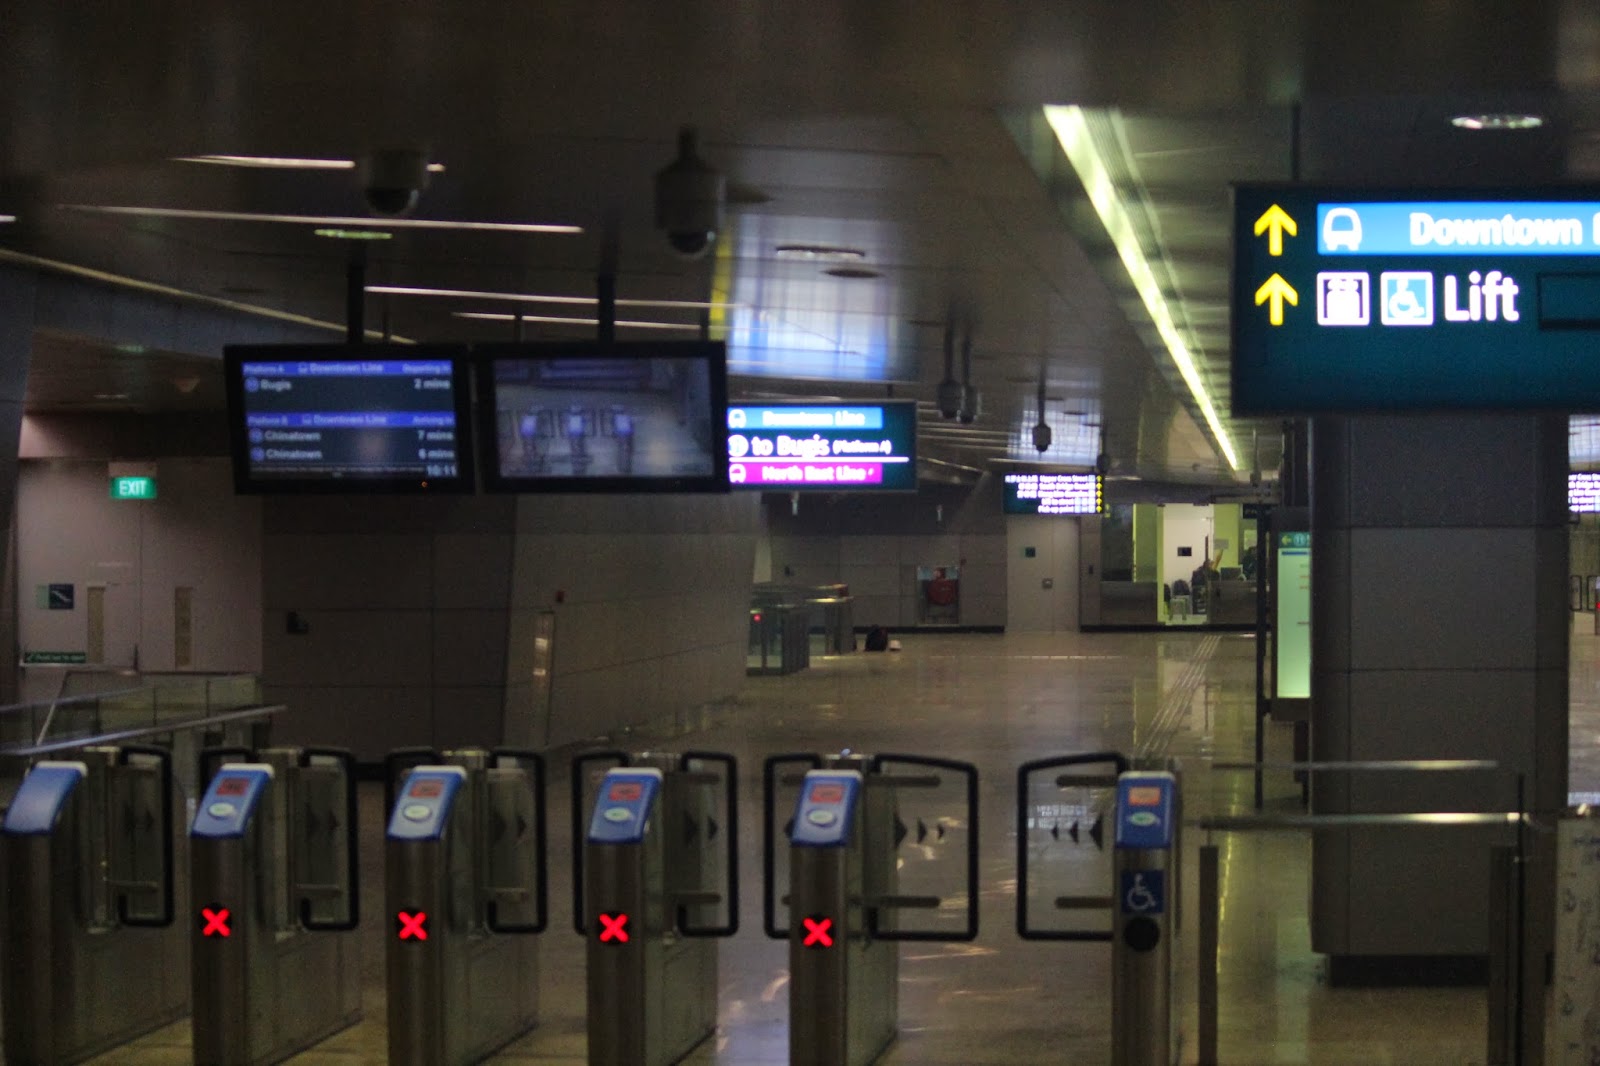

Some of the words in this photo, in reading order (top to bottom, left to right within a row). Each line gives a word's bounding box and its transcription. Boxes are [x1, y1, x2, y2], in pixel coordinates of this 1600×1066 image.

[1409, 212, 1583, 246] Downtown
[1444, 270, 1520, 322] Lift
[309, 362, 360, 373] Downtown
[361, 362, 384, 373] Line
[260, 379, 292, 392] Bugis
[313, 414, 363, 426] Downtown
[365, 414, 387, 425] Line
[835, 410, 866, 426] Line
[264, 430, 321, 442] Chinatown
[265, 448, 323, 460] Chinatown
[751, 436, 774, 456] to
[777, 434, 830, 458] Bugis
[761, 466, 803, 481] North
[804, 465, 834, 481] East
[836, 465, 867, 481] Line
[118, 480, 147, 496] EXIT
